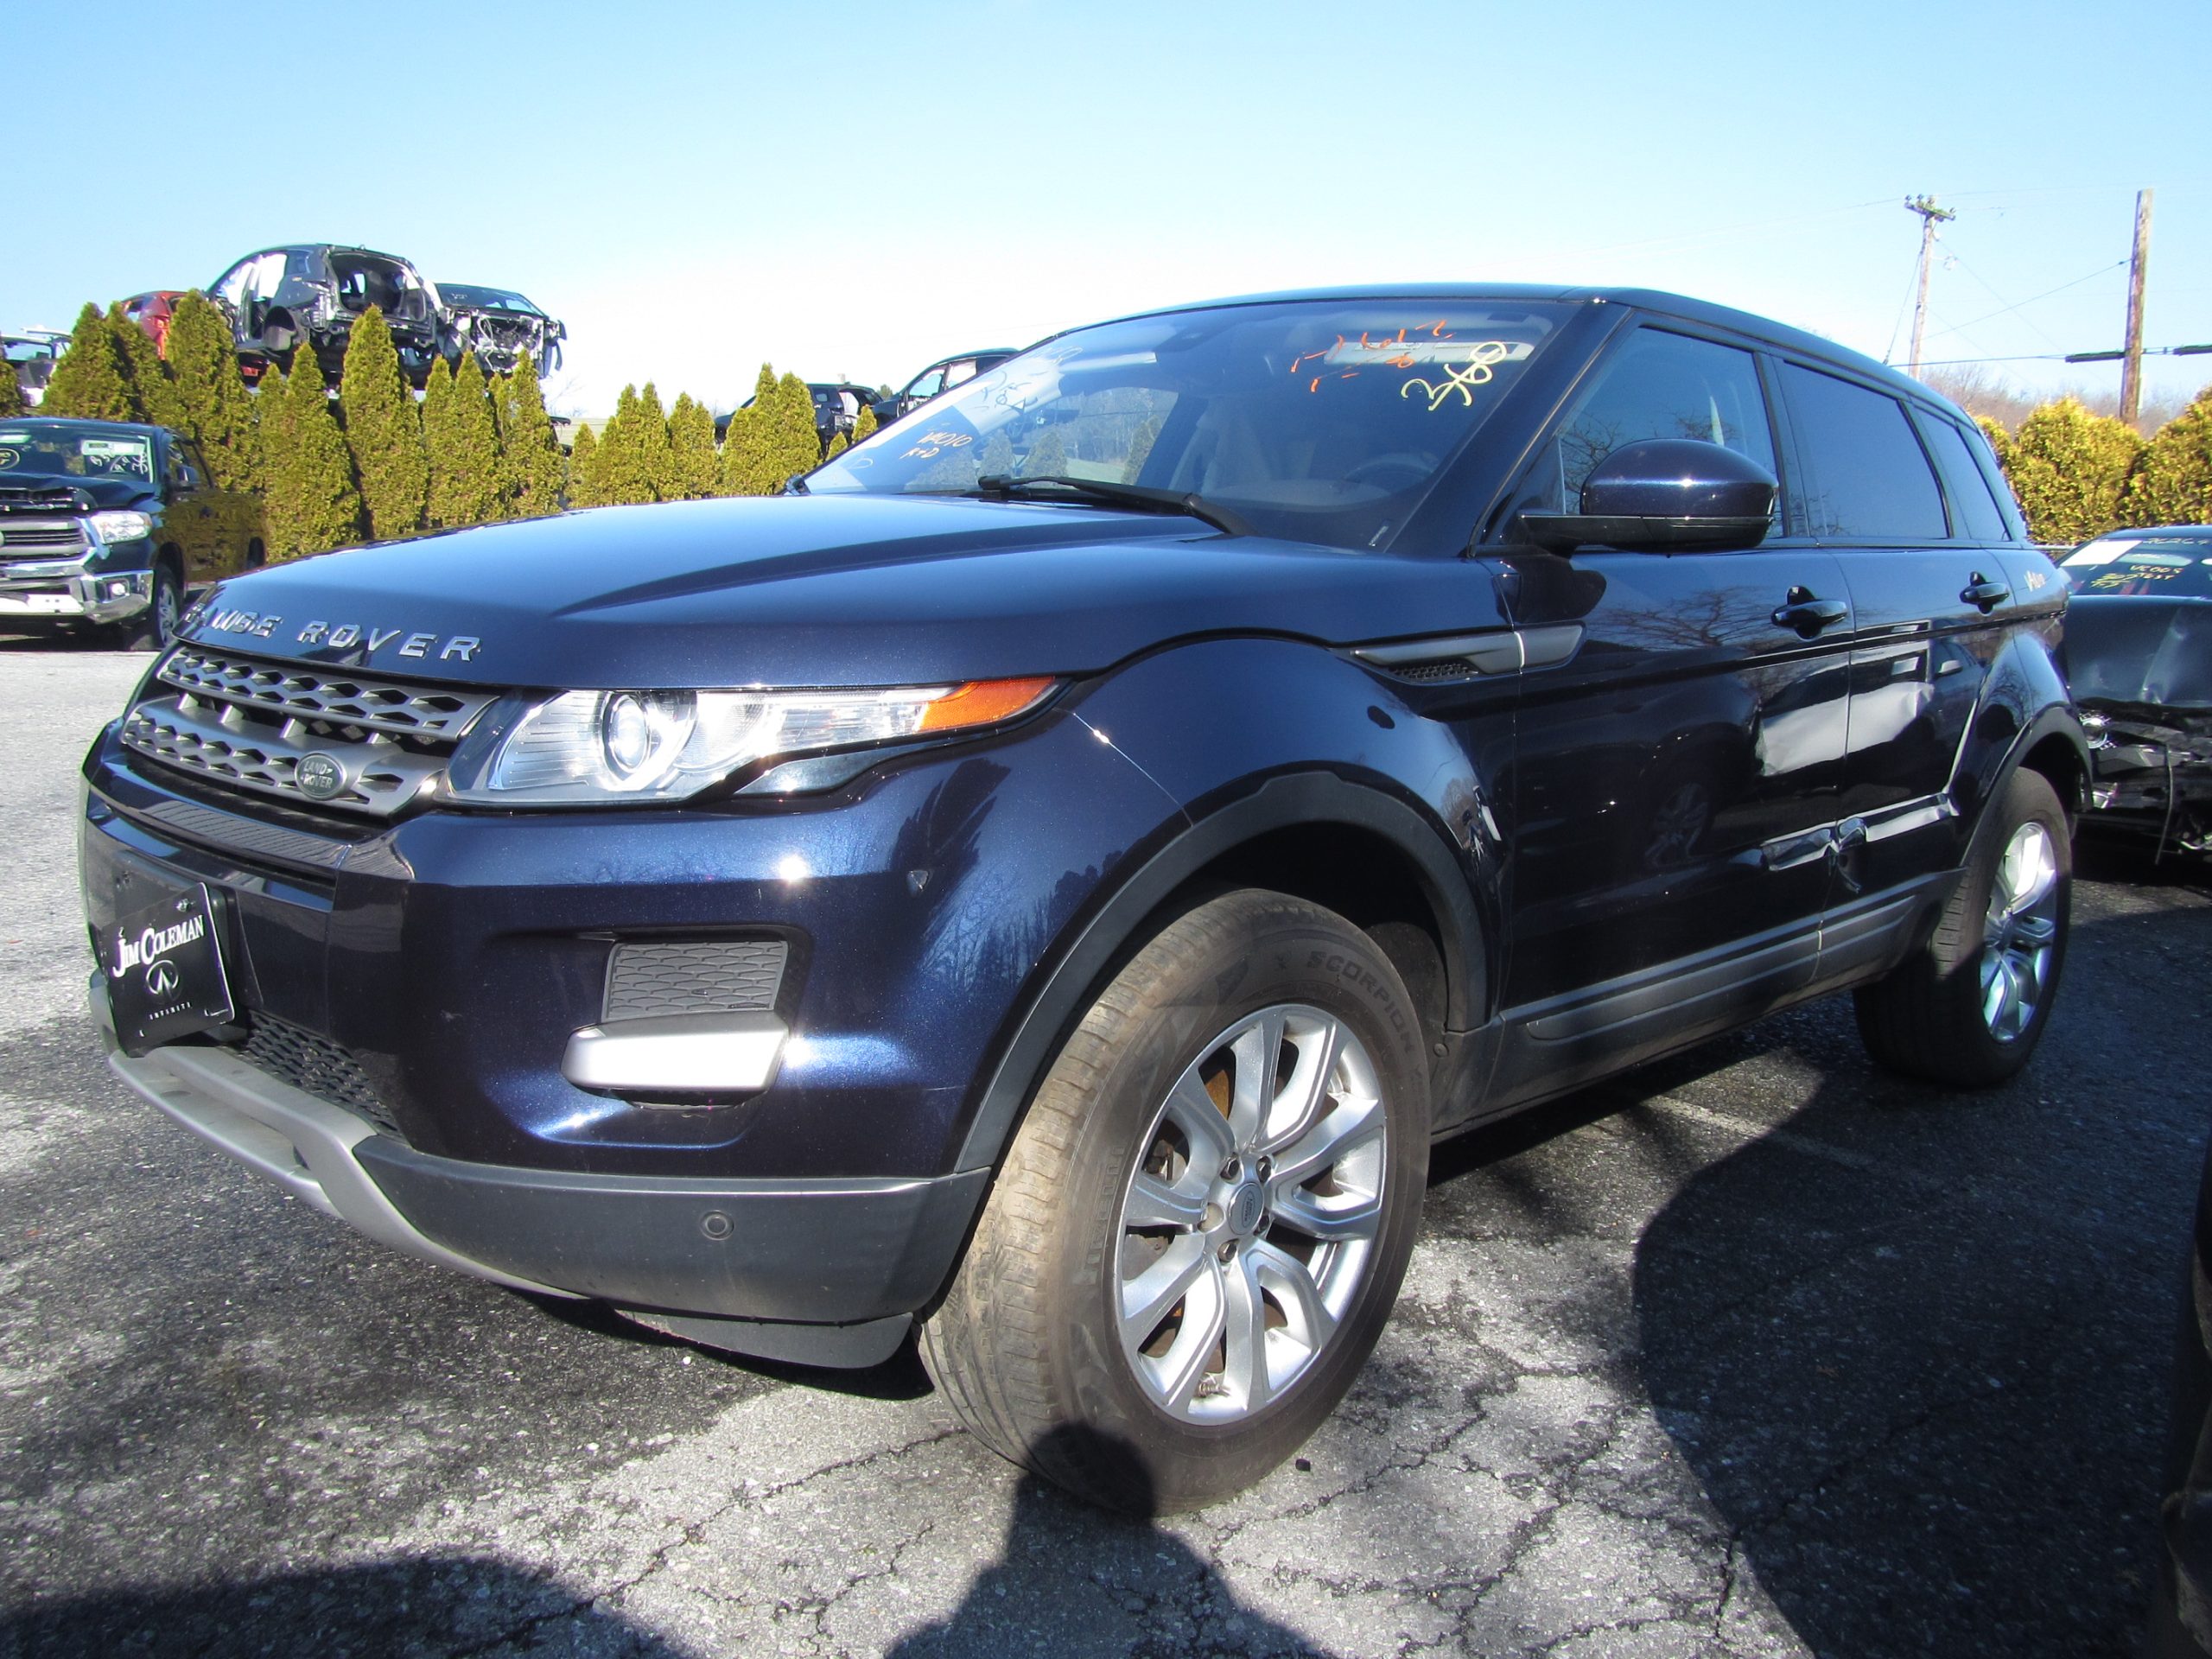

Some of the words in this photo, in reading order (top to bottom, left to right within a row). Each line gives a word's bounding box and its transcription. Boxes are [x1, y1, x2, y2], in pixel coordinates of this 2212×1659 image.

[297, 620, 483, 663] ROVER
[302, 760, 328, 775] LAND
[302, 772, 334, 789] ROVER
[112, 938, 141, 978] JIM
[140, 914, 205, 965] COLEMAN
